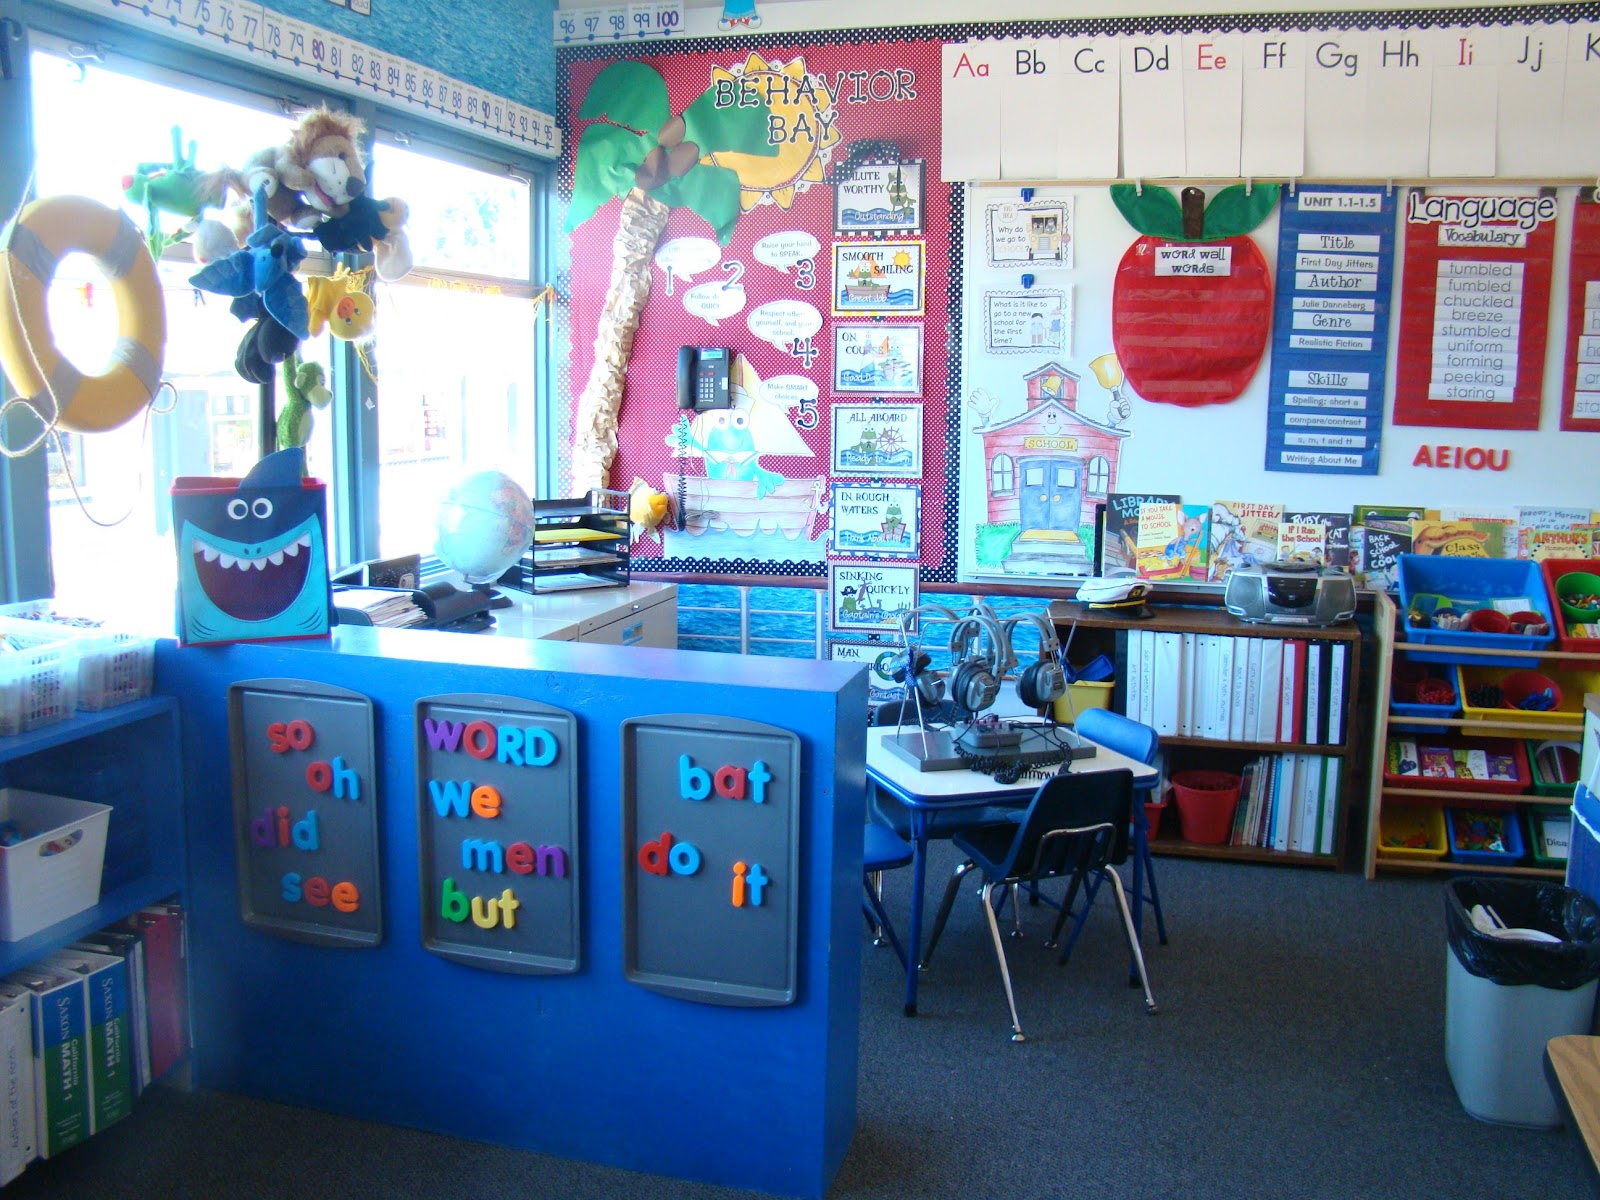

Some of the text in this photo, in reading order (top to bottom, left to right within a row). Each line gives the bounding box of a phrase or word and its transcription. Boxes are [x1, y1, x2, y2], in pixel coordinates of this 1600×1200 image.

[559, 11, 679, 35] 96 97 98 99 100
[953, 32, 1600, 78] Aa Bb Cc Dd Ee Ff Gg Hh Ii Jj K
[193, 0, 211, 22] 75
[220, 6, 234, 31] 76
[243, 15, 258, 38] 77
[267, 24, 281, 47] 78
[289, 32, 304, 55] 79
[312, 38, 325, 62] 80
[331, 47, 342, 68] 81
[351, 54, 364, 75] 82
[370, 60, 381, 81] 83
[387, 67, 400, 87] 84
[405, 73, 416, 92] 85
[422, 79, 433, 98] 86
[439, 85, 447, 103] 87
[452, 91, 462, 109] 88
[467, 96, 478, 115] 89
[482, 100, 490, 119] 90
[494, 105, 502, 123] 91
[508, 111, 516, 128] 92
[519, 116, 528, 132] 93
[532, 120, 540, 137] 94
[544, 124, 553, 140] 95
[714, 68, 917, 109] BEHAVIOR
[767, 110, 839, 145] BAY
[843, 184, 885, 195] WORTHY
[1304, 197, 1376, 208] UNIT 1.1-1.5
[854, 211, 905, 224] Outstanding
[1409, 193, 1555, 230] Language
[998, 226, 1013, 235] Why
[1445, 228, 1521, 246] Vocabulary
[1320, 235, 1355, 250] Title
[842, 251, 884, 262] SMOOTH
[1301, 257, 1374, 269] First Day Jitters
[722, 258, 816, 292] 2 3
[873, 264, 914, 275] SAILING
[1307, 273, 1362, 289] Author
[1448, 278, 1511, 292] fumbled
[1301, 300, 1366, 311] Julie Danneberg
[1443, 294, 1514, 308] chuckled
[1312, 314, 1352, 328] Genre
[1451, 308, 1504, 322] breeze
[841, 331, 857, 342] ON
[1441, 325, 1512, 338] stumbled
[1298, 337, 1363, 349] Realistic Fiction
[1447, 340, 1504, 353] uniform
[792, 337, 818, 367] 4
[1447, 354, 1504, 370] forming
[1307, 371, 1348, 387] Skills
[1443, 371, 1505, 387] peeking
[1446, 386, 1496, 402] staring
[1329, 397, 1351, 406] short
[797, 398, 818, 429] 5
[847, 412, 908, 424] ALL ABOARD
[1289, 416, 1362, 427] compare/contrast
[1027, 438, 1075, 450] SCHOOL
[1328, 437, 1343, 445] and
[1286, 454, 1357, 465] Writing About Me
[841, 491, 890, 502] IN ROUGH
[841, 505, 879, 515] WATERS
[1232, 502, 1275, 512] FIRST DAY
[1240, 509, 1281, 519] JITTERS
[1301, 526, 1316, 535] Ran
[1296, 534, 1322, 543] School
[1368, 534, 1391, 544] BACK
[1445, 542, 1480, 553] Class
[839, 571, 883, 582] SINKING
[866, 585, 911, 596] QUICKLY
[837, 647, 860, 659] MAN
[265, 719, 314, 754] so
[424, 718, 558, 767] WORD
[306, 756, 361, 800] oh
[679, 753, 772, 804] bat
[251, 806, 320, 850] did
[462, 838, 566, 879] men
[638, 831, 701, 876] do
[731, 861, 769, 908] it
[281, 872, 360, 913] see
[441, 877, 520, 929] but
[102, 976, 116, 1067] SAXON MATH
[57, 996, 72, 1090] SAXON MATH
[114, 1017, 122, 1063] California
[70, 1038, 79, 1086] California
